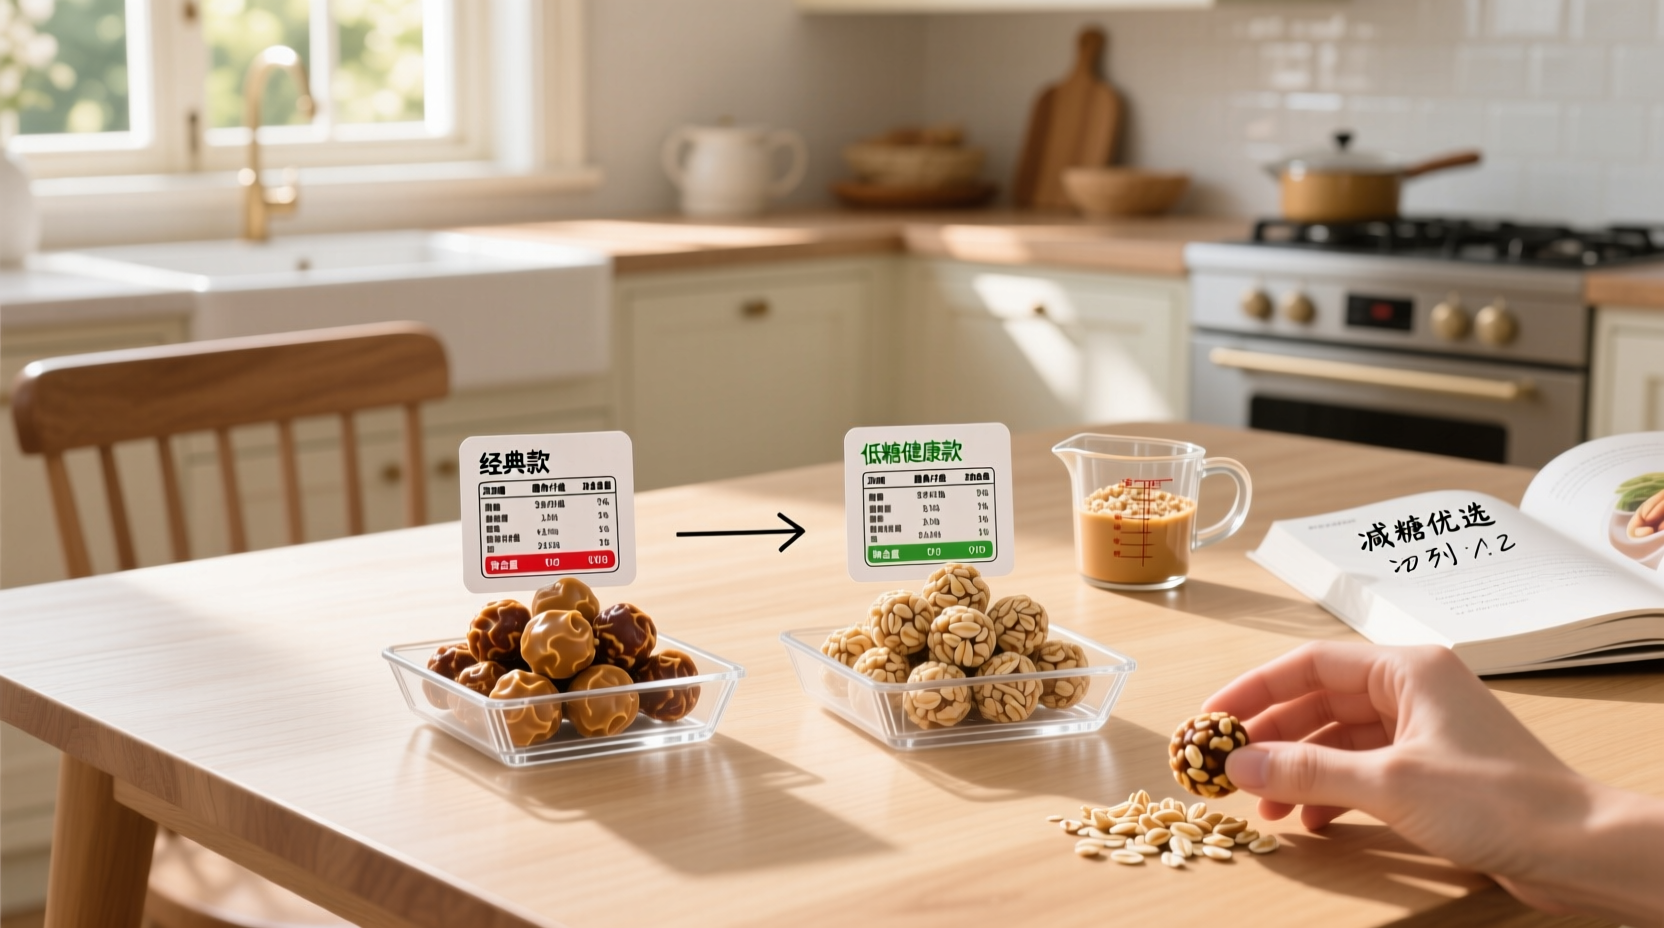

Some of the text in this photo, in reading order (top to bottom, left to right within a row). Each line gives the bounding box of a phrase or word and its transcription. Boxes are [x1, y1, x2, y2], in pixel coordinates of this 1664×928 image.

[479, 449, 551, 475] 经典款
[861, 439, 963, 465] 低糖健康款
[1357, 501, 1497, 552] 减糖优选
